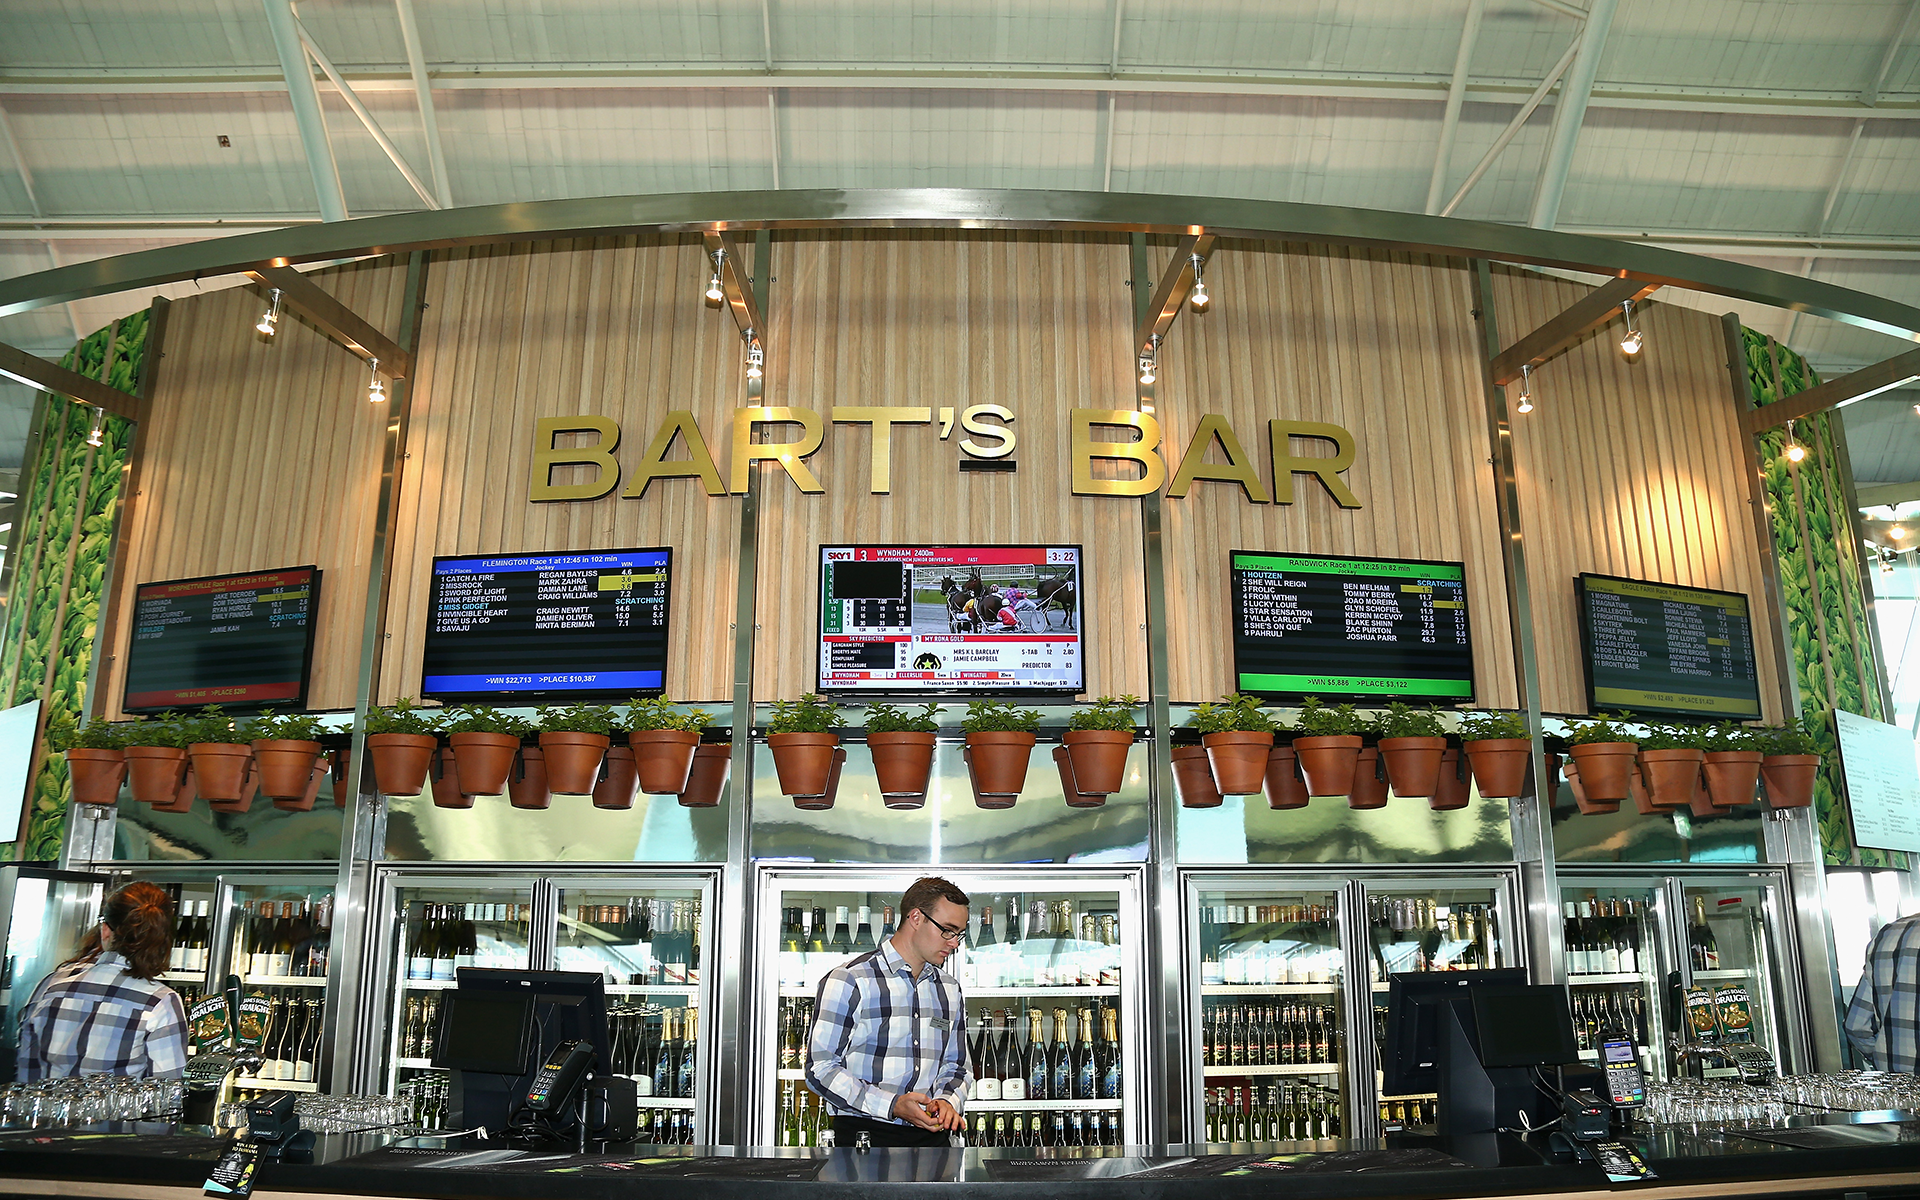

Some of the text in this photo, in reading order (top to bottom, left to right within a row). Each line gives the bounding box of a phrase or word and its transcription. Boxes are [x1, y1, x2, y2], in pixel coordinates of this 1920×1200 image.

[530, 404, 1362, 509] BART'S BAR
[828, 552, 850, 560] SKY1
[860, 550, 867, 561] 3
[482, 559, 528, 567] FLEMINGTON
[1289, 560, 1328, 568] RANDWICK
[1416, 580, 1461, 588] SCRATCHING
[1715, 994, 1750, 1005] DRAUGHT
[190, 1002, 226, 1021] DRAUGHT
[1740, 1052, 1771, 1060] BART'S
[187, 1062, 222, 1071] BART'S
[190, 1071, 211, 1080] BAR
